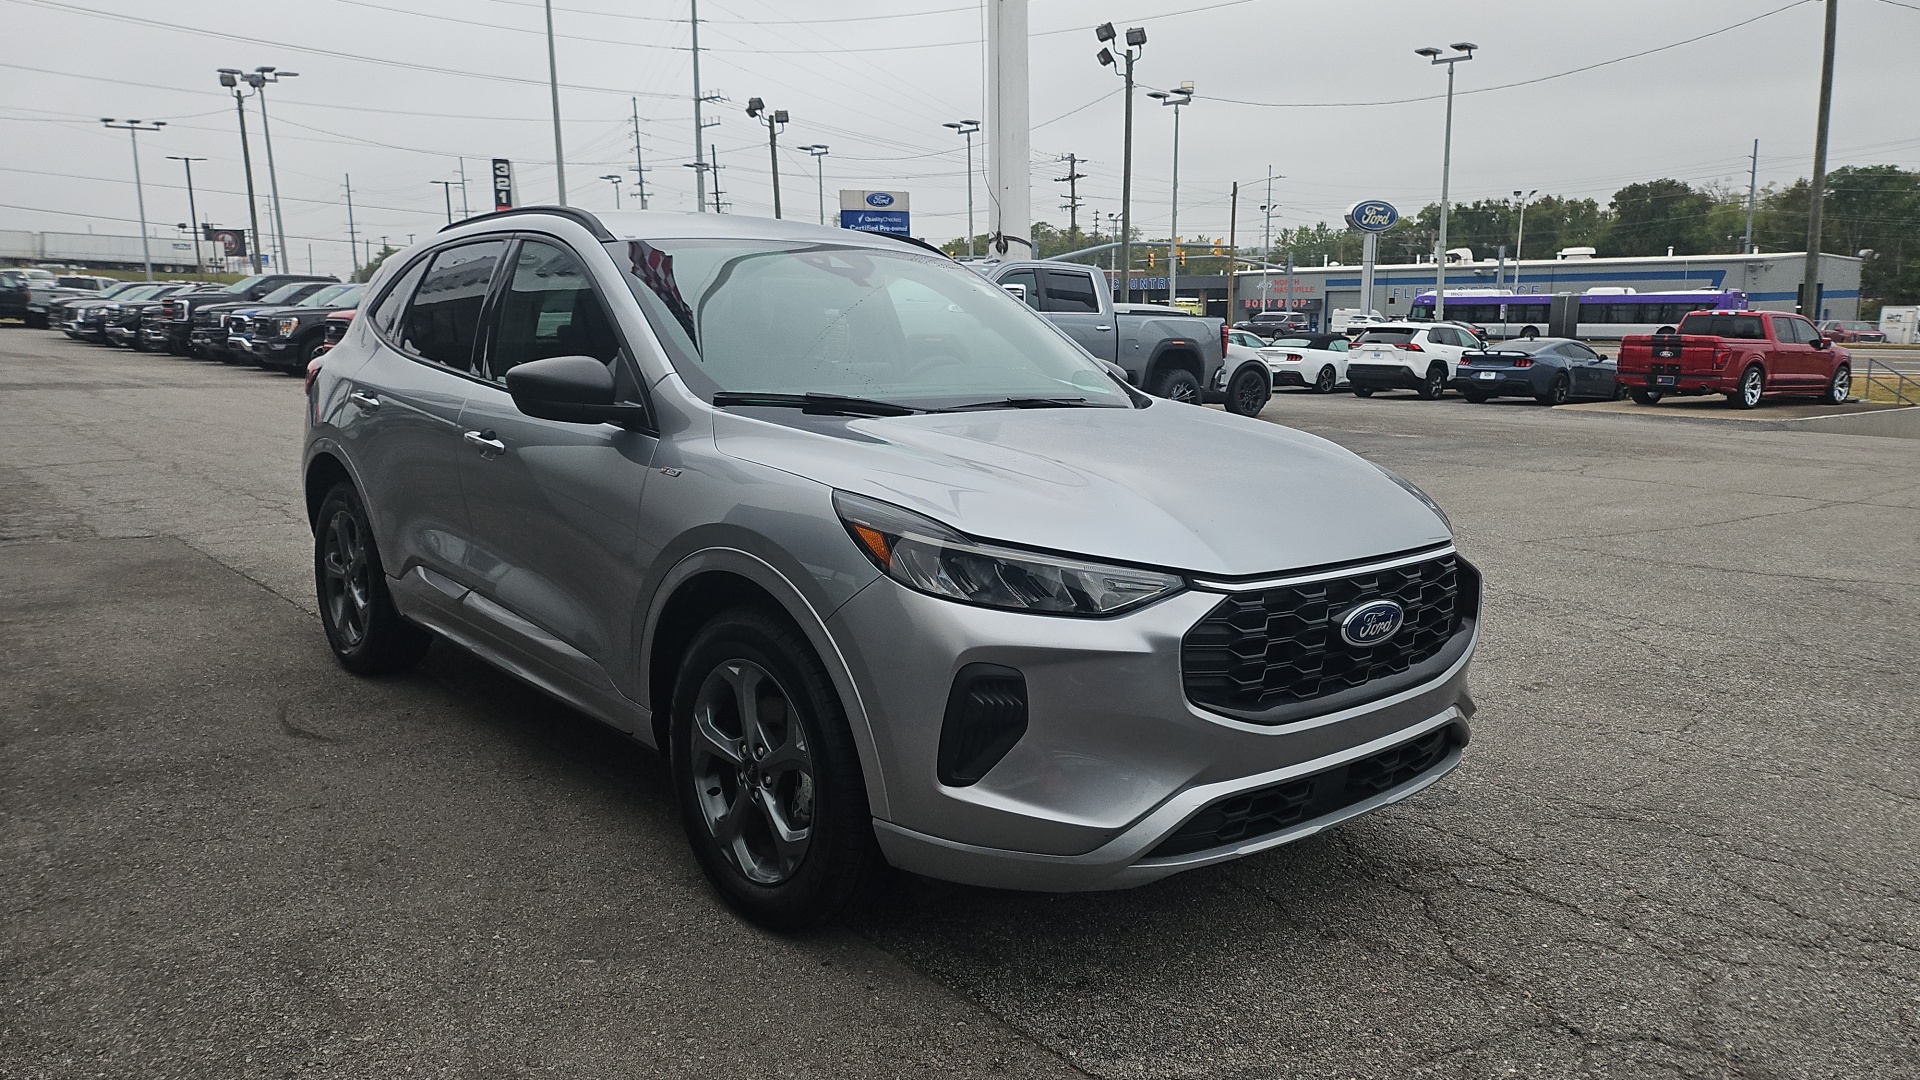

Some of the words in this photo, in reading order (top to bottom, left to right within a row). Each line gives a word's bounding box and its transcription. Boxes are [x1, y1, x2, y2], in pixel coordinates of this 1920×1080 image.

[872, 195, 891, 205] Ford
[1361, 205, 1391, 225] Ford
[849, 224, 879, 232] Certified
[1112, 277, 1171, 290] CUNTR
[1393, 287, 1448, 299] FLE
[1359, 610, 1394, 638] Ford
